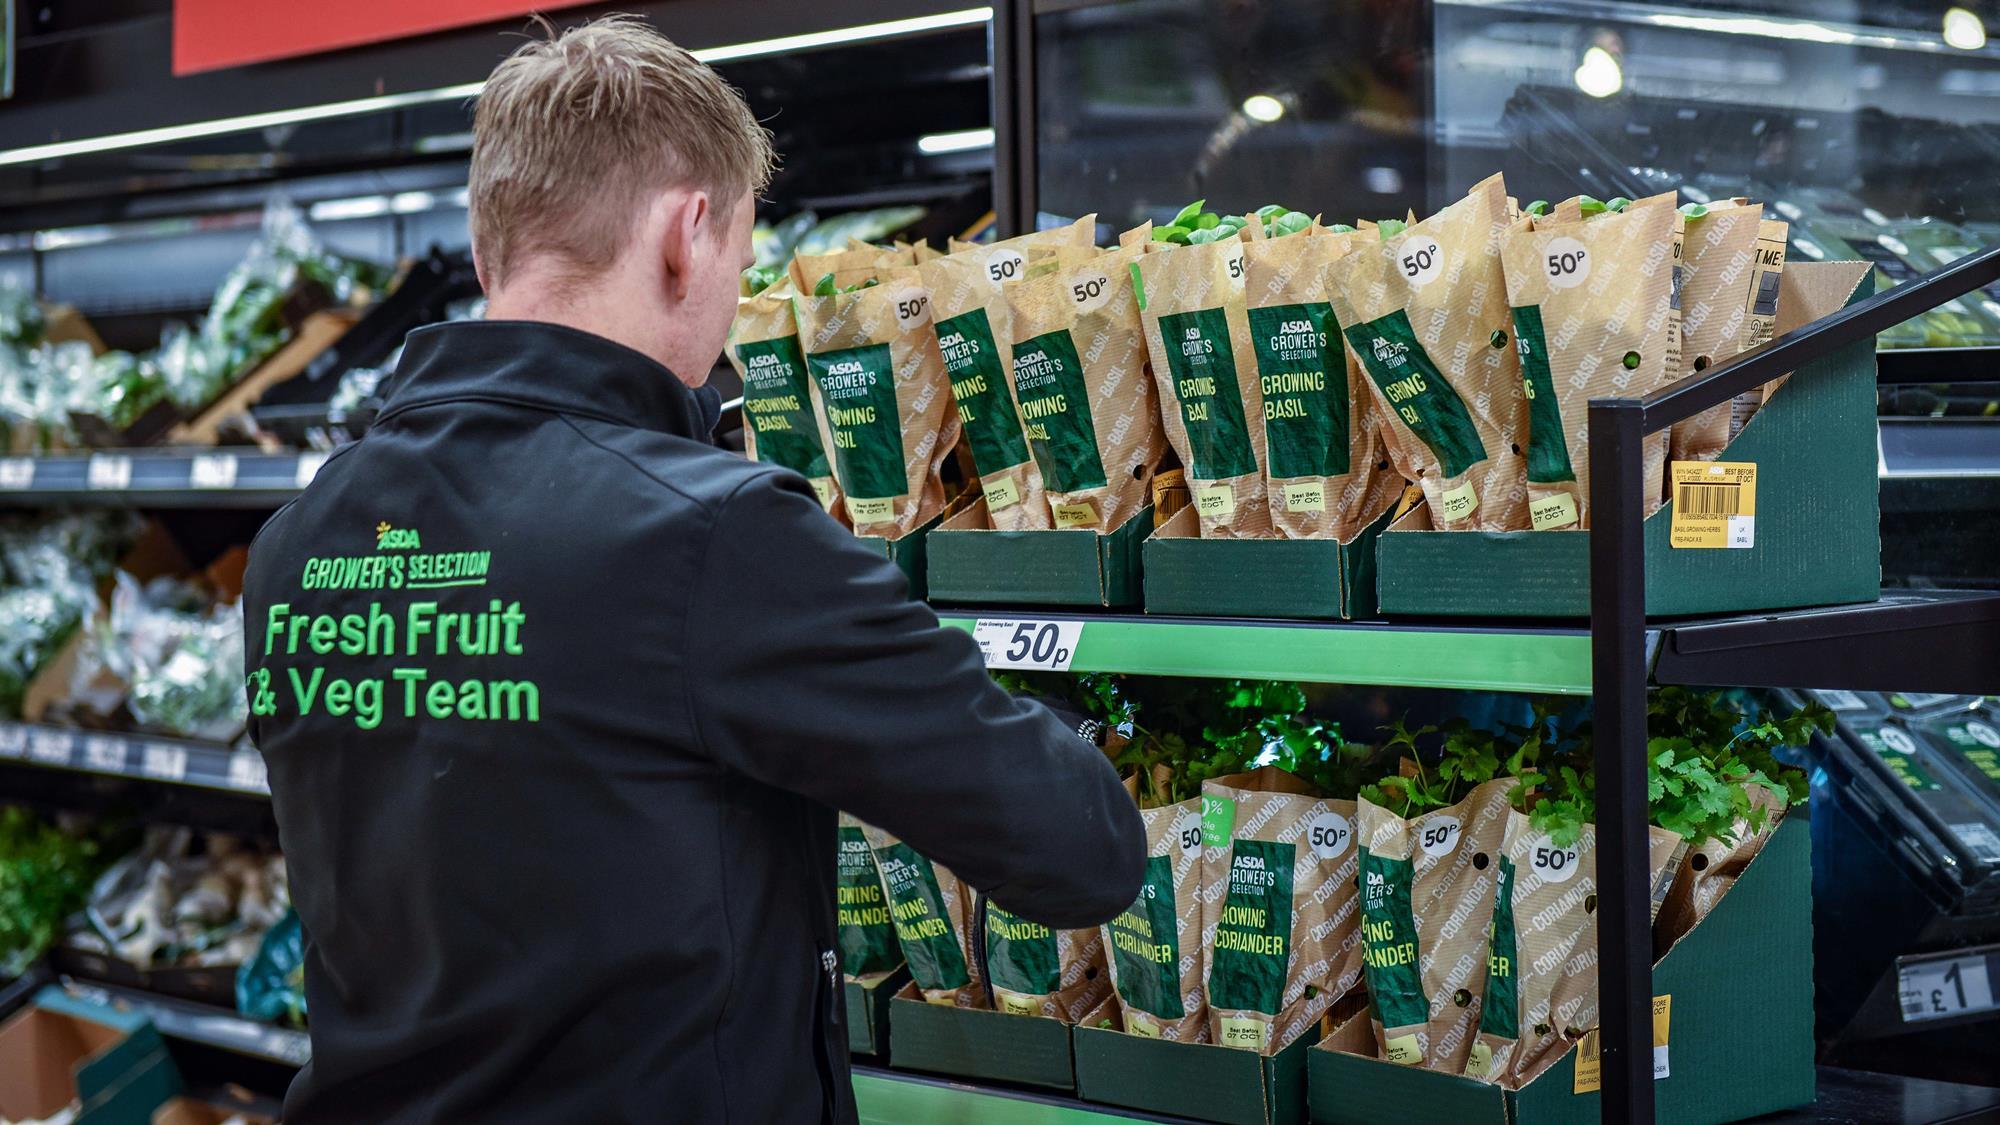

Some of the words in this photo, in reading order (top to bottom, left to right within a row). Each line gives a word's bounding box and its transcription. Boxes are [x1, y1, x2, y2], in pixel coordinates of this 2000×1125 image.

[1484, 221, 1510, 257] BASIL
[1705, 213, 1740, 246] BASIL
[1402, 244, 1437, 277] 50P
[1548, 250, 1585, 276] 50P
[1640, 240, 1671, 277] BASIL
[1719, 249, 1751, 286] BASIL
[1267, 262, 1299, 295] BASIL
[1589, 259, 1620, 296] BASIL
[1364, 281, 1387, 315] BASIL
[1467, 281, 1489, 318] BASIL
[1280, 320, 1313, 334] ASDA
[1425, 308, 1449, 345] BASIL
[1605, 297, 1637, 335] BASIL
[1681, 301, 1714, 337] BASIL
[816, 315, 846, 343] BASIL
[939, 332, 965, 349] SDA
[1553, 314, 1587, 351] BASIL
[942, 340, 979, 363] OWER'S
[1085, 332, 1109, 363] BASIL
[1271, 332, 1327, 351] GROWER'S
[749, 354, 780, 368] ASDA
[1013, 350, 1048, 369] ASDA
[1281, 349, 1317, 361] SELECTION
[1451, 340, 1473, 378] BASIL
[828, 361, 864, 376] ASDA
[1013, 359, 1063, 382] ROWER'S
[1569, 354, 1603, 390] BASIL
[754, 378, 788, 390] SELECTION
[820, 371, 877, 391] GROWER'S
[952, 375, 987, 400] WING
[1017, 374, 1056, 391] SELECTION
[1099, 366, 1126, 398] BASIL
[1261, 372, 1325, 395] GROWING
[746, 395, 800, 413] GROWING
[830, 386, 868, 400] SELECTION
[1020, 394, 1067, 420] OWING
[1264, 398, 1307, 420] BASIL
[755, 415, 792, 432] BASIL
[1028, 423, 1051, 440] ASIL
[1107, 413, 1134, 445] BASIL
[1737, 468, 1754, 476] BEFORE
[988, 491, 1008, 503] OCT
[1337, 482, 1360, 513] BASIL
[1451, 498, 1470, 512] OCT
[1544, 504, 1561, 513] Before
[1544, 509, 1566, 520] OCT
[377, 529, 421, 550] ASDA
[301, 555, 405, 591] GROWER'S
[408, 551, 491, 579] SELECTION
[265, 602, 395, 655] Fresh
[406, 599, 526, 655] Fruit
[1006, 623, 1069, 669] 50p
[250, 667, 277, 716] &
[287, 667, 384, 730] Veg
[392, 668, 539, 721] Team
[841, 841, 870, 853] ASDA
[1182, 828, 1201, 849] 50
[1312, 827, 1347, 848] 50P
[881, 858, 905, 873] SDA
[1233, 855, 1265, 870] ASDA
[1432, 835, 1479, 899] CORIANDER
[1535, 847, 1576, 870] 50P
[1231, 868, 1275, 886] ROWER'S
[1367, 871, 1384, 885] DA
[838, 884, 880, 905] OWING
[1231, 884, 1265, 896] SELECTION
[1440, 875, 1492, 940] CORIANDER
[1532, 877, 1596, 932] CORIANDER
[1223, 905, 1266, 929] ROWING
[1214, 929, 1283, 956] CORIANDER
[1931, 962, 1967, 1013] £1
